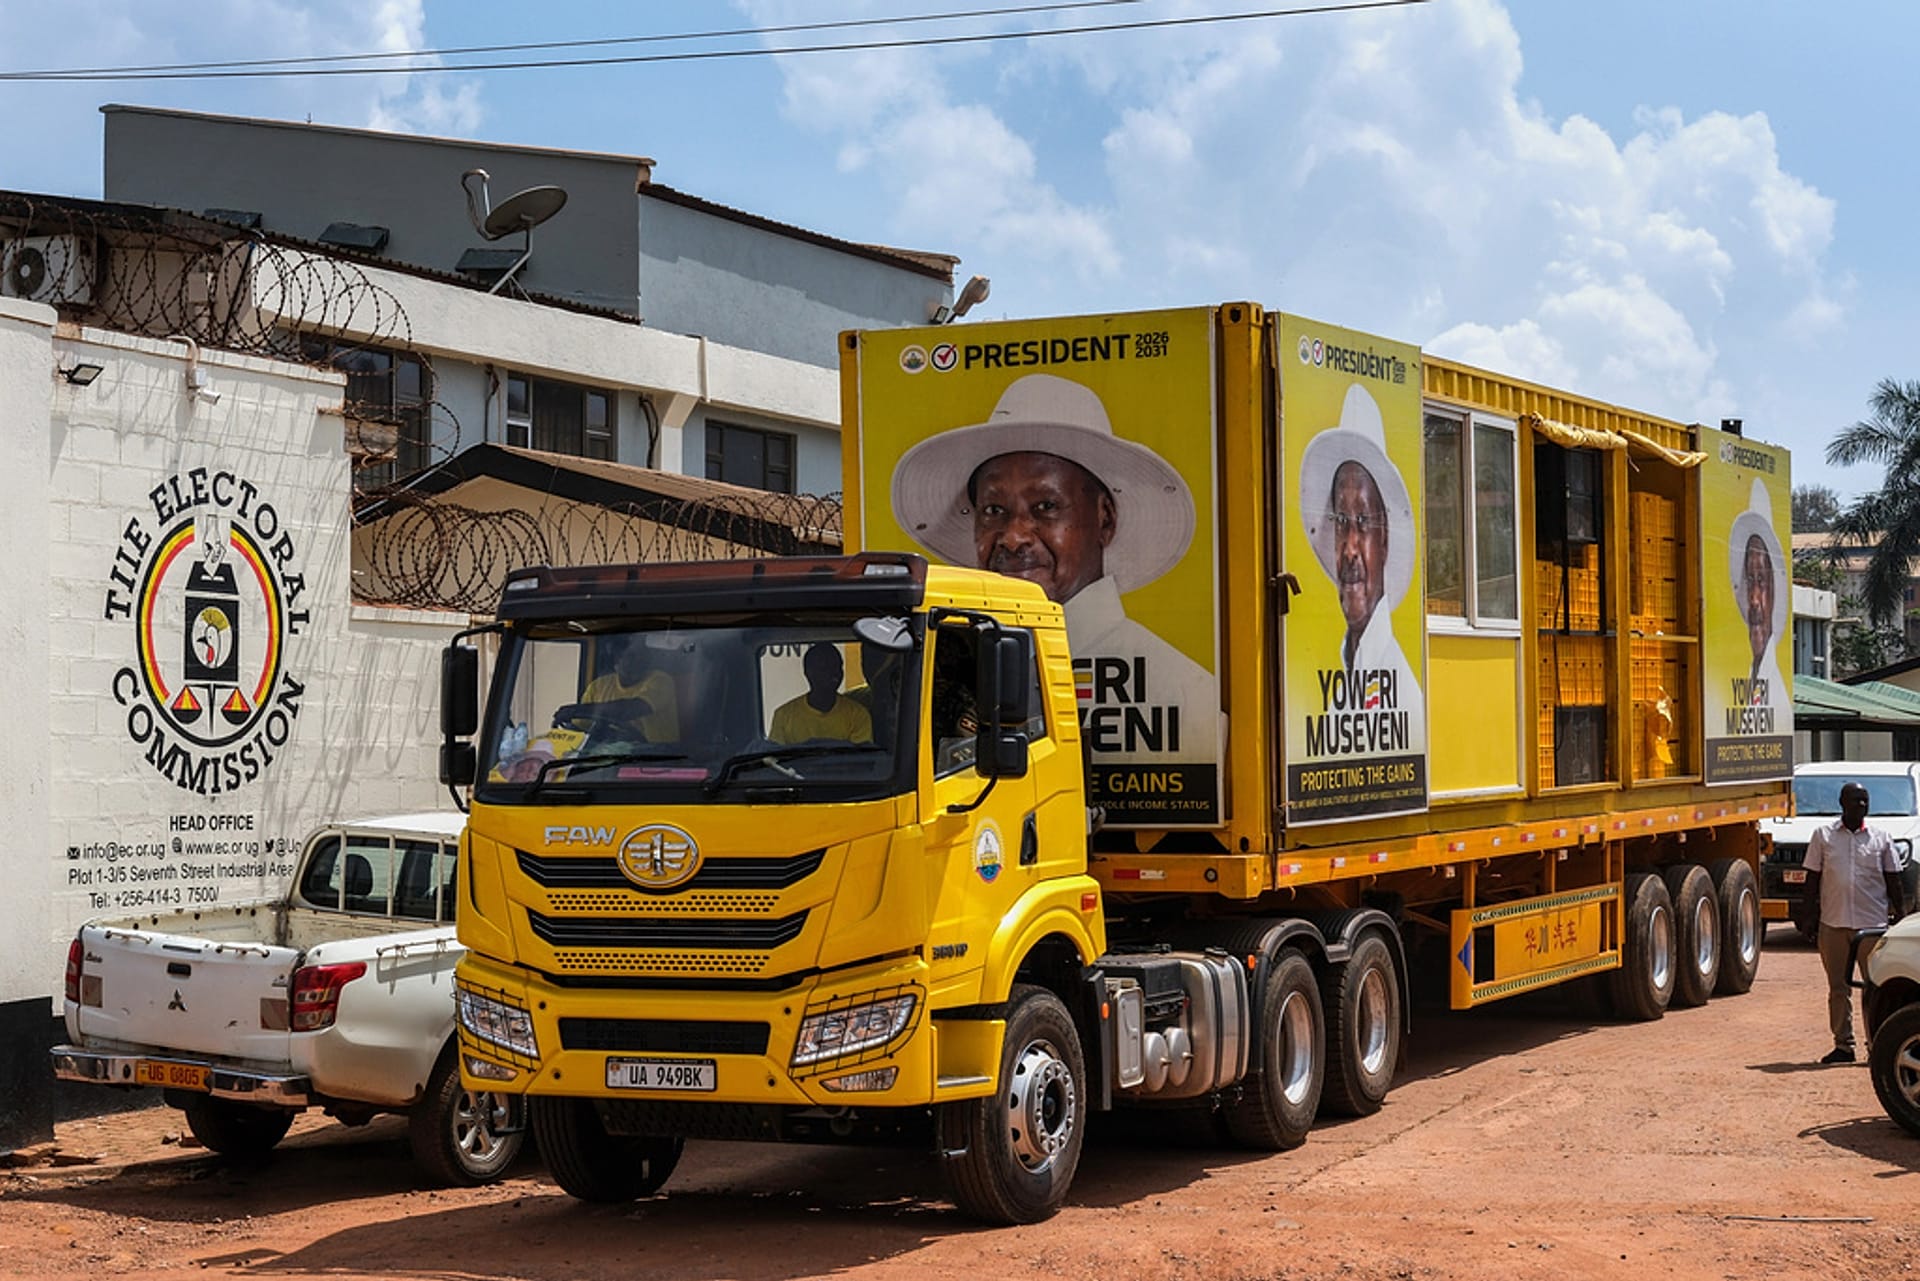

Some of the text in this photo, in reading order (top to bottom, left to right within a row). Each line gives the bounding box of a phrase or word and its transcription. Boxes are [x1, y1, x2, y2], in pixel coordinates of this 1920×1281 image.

[965, 332, 1169, 369] PRESIDENT 2026
[1135, 344, 1168, 358] 2031
[1326, 344, 1392, 382] PRESIDENT
[149, 467, 310, 635] ELECTORAL
[1072, 656, 1146, 704] ERI
[1317, 669, 1398, 712] YOWERI
[112, 667, 305, 795] COMMISSION
[1078, 705, 1179, 752] ENI
[1306, 711, 1409, 757] MUSEVENI
[1108, 773, 1184, 793] GAINS
[1300, 762, 1416, 793] PROTECTING THE GAINS
[1128, 800, 1170, 810] INCOME
[1170, 800, 1210, 810] STATUS
[169, 815, 254, 831] HEAD OFFICE
[544, 825, 617, 846] FAW
[68, 867, 93, 885] Plot
[96, 865, 127, 884] 1-3/5
[129, 864, 178, 882] Seventh
[180, 862, 215, 879] Street
[216, 861, 267, 877] Industrial
[89, 892, 111, 909] Tel:
[629, 1065, 703, 1087] UA 949BK
